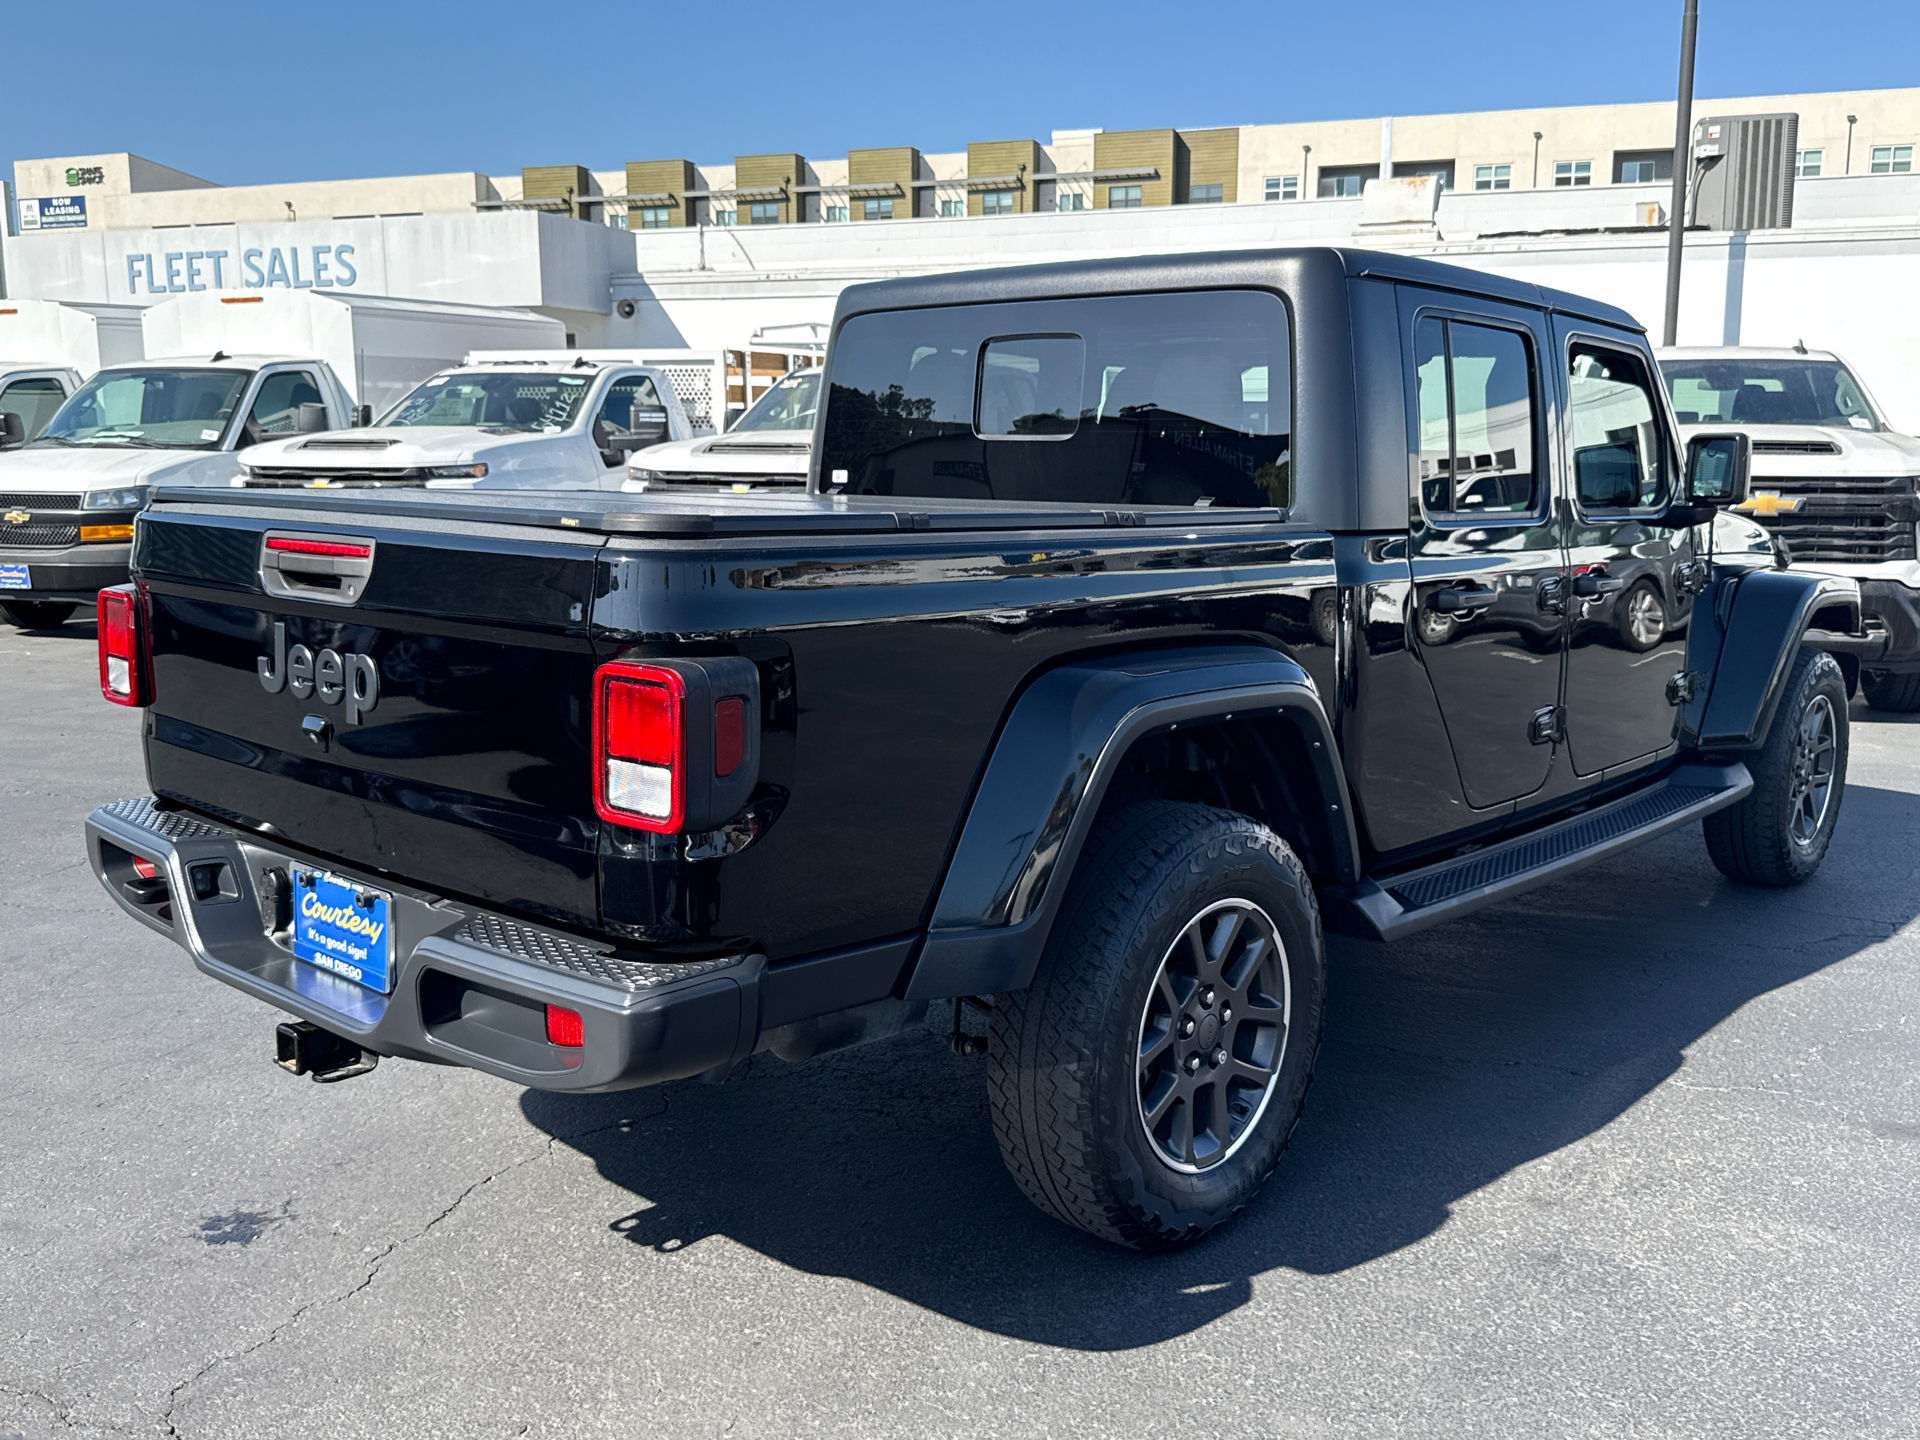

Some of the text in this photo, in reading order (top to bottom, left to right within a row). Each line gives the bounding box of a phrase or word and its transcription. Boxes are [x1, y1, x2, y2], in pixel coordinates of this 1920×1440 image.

[44, 205, 80, 215] LEASING
[52, 198, 71, 206] NOW
[127, 244, 357, 294] FLEET SALES
[257, 621, 381, 726] Jeep
[301, 892, 384, 946] Courtesy
[309, 927, 368, 961] It's a good sign!
[314, 951, 362, 981] SAN DIEGO
